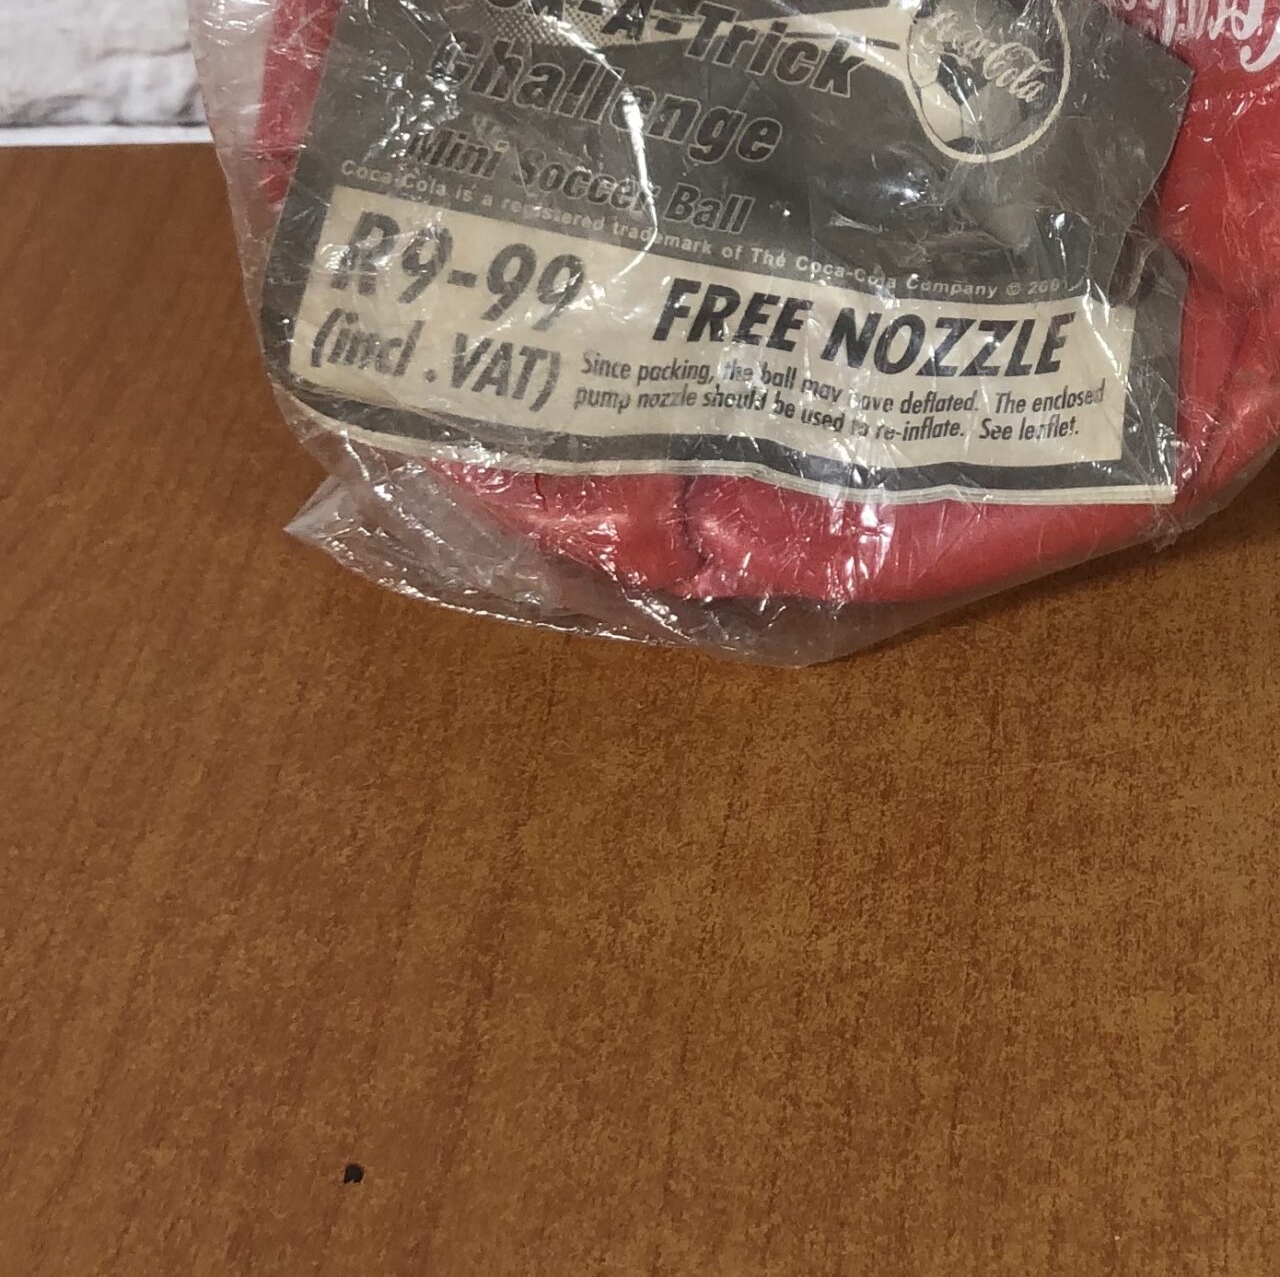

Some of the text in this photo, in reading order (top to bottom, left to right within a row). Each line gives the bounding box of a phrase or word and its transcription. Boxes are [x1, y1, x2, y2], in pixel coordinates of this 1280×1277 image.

[408, 126, 755, 235] Mini Soccer Ball
[332, 211, 586, 333] R9-99
[457, 184, 474, 202] is
[480, 193, 493, 206] a
[501, 197, 604, 231] registered
[613, 221, 713, 255] trademark
[721, 244, 743, 260] of
[750, 246, 786, 269] The
[795, 255, 897, 290] Coca-Cola
[906, 273, 998, 300] Company
[652, 278, 1076, 379] FREE NOZZLE
[573, 384, 631, 414] pump
[637, 383, 697, 408] nozzle
[702, 384, 769, 410] should
[773, 390, 796, 419] be
[801, 407, 846, 433] used
[875, 415, 965, 442] re-inflate.
[979, 418, 1013, 441] See
[581, 350, 1106, 414] Since packing, the ball may ave deflated. The enclosed
